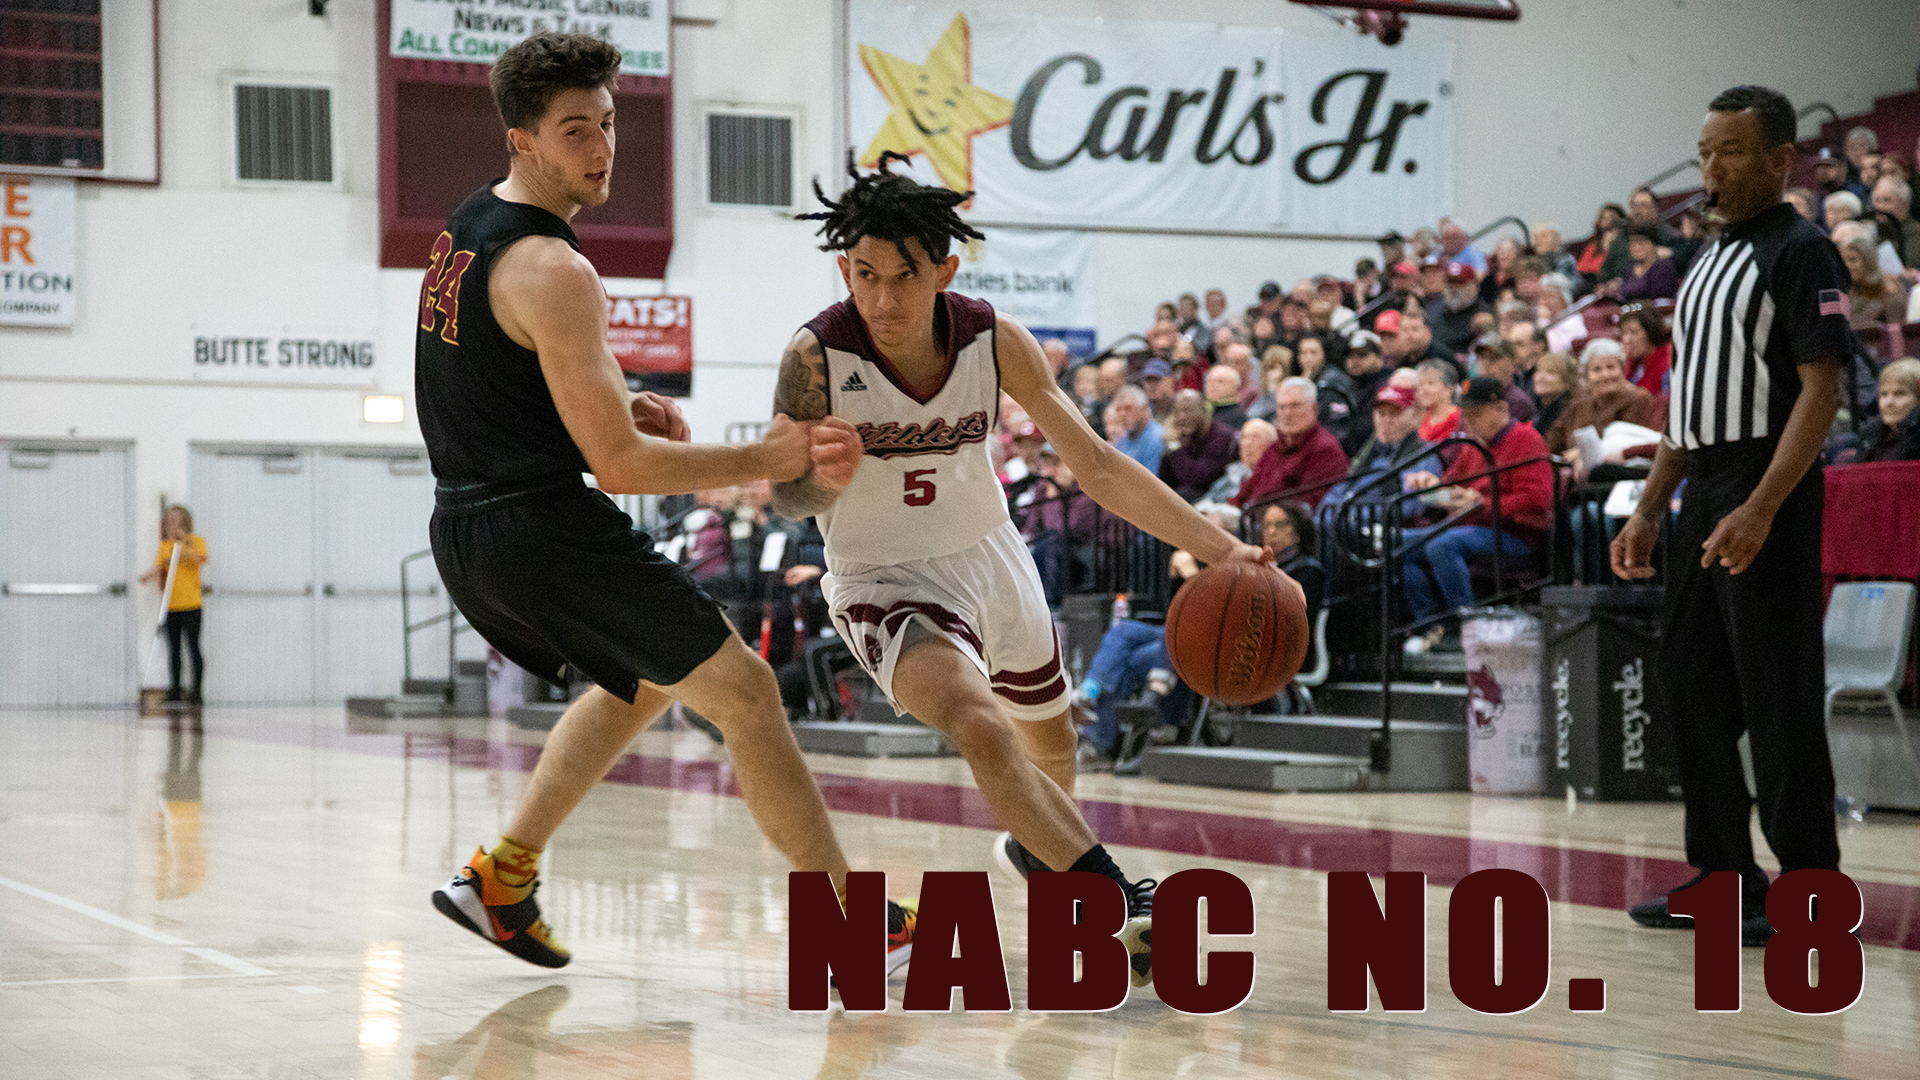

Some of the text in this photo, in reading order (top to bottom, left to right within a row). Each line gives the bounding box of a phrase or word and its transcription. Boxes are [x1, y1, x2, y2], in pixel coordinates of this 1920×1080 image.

[454, 7, 525, 34] NEWS
[398, 27, 442, 53] ALL
[1008, 52, 1430, 184] Carl's Jr.
[421, 230, 476, 346] 24
[1013, 268, 1074, 295] bank
[0, 299, 60, 315] OMPANY
[194, 336, 374, 368] BUTTE STRONG
[903, 468, 937, 507] 5
